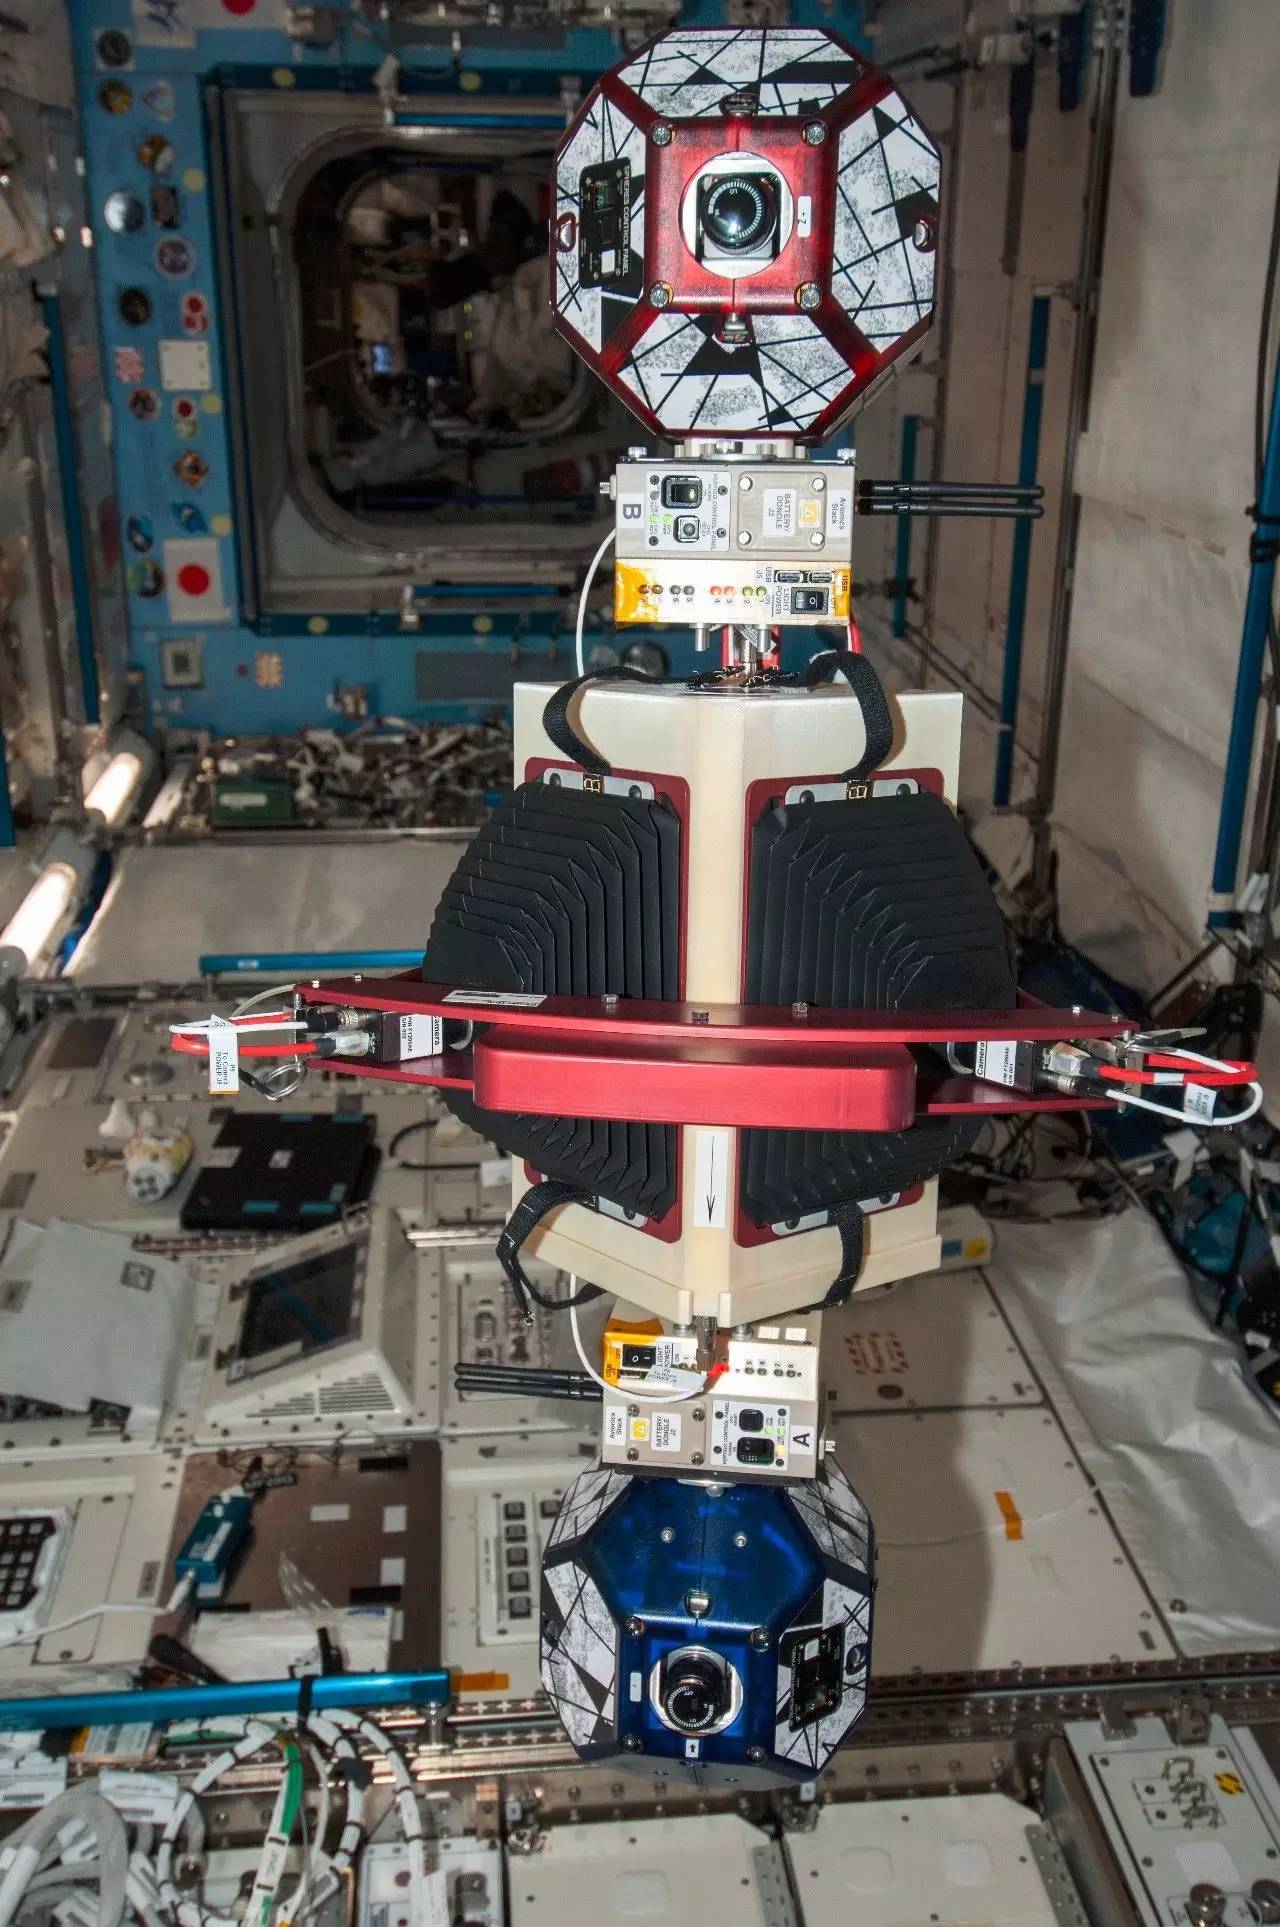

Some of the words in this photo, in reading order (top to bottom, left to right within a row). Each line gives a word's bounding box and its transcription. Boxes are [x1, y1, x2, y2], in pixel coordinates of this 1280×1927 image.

[623, 503, 641, 520] B
[839, 497, 847, 530] Avionics
[674, 1353, 679, 1363] ON
[793, 1433, 810, 1448] A
